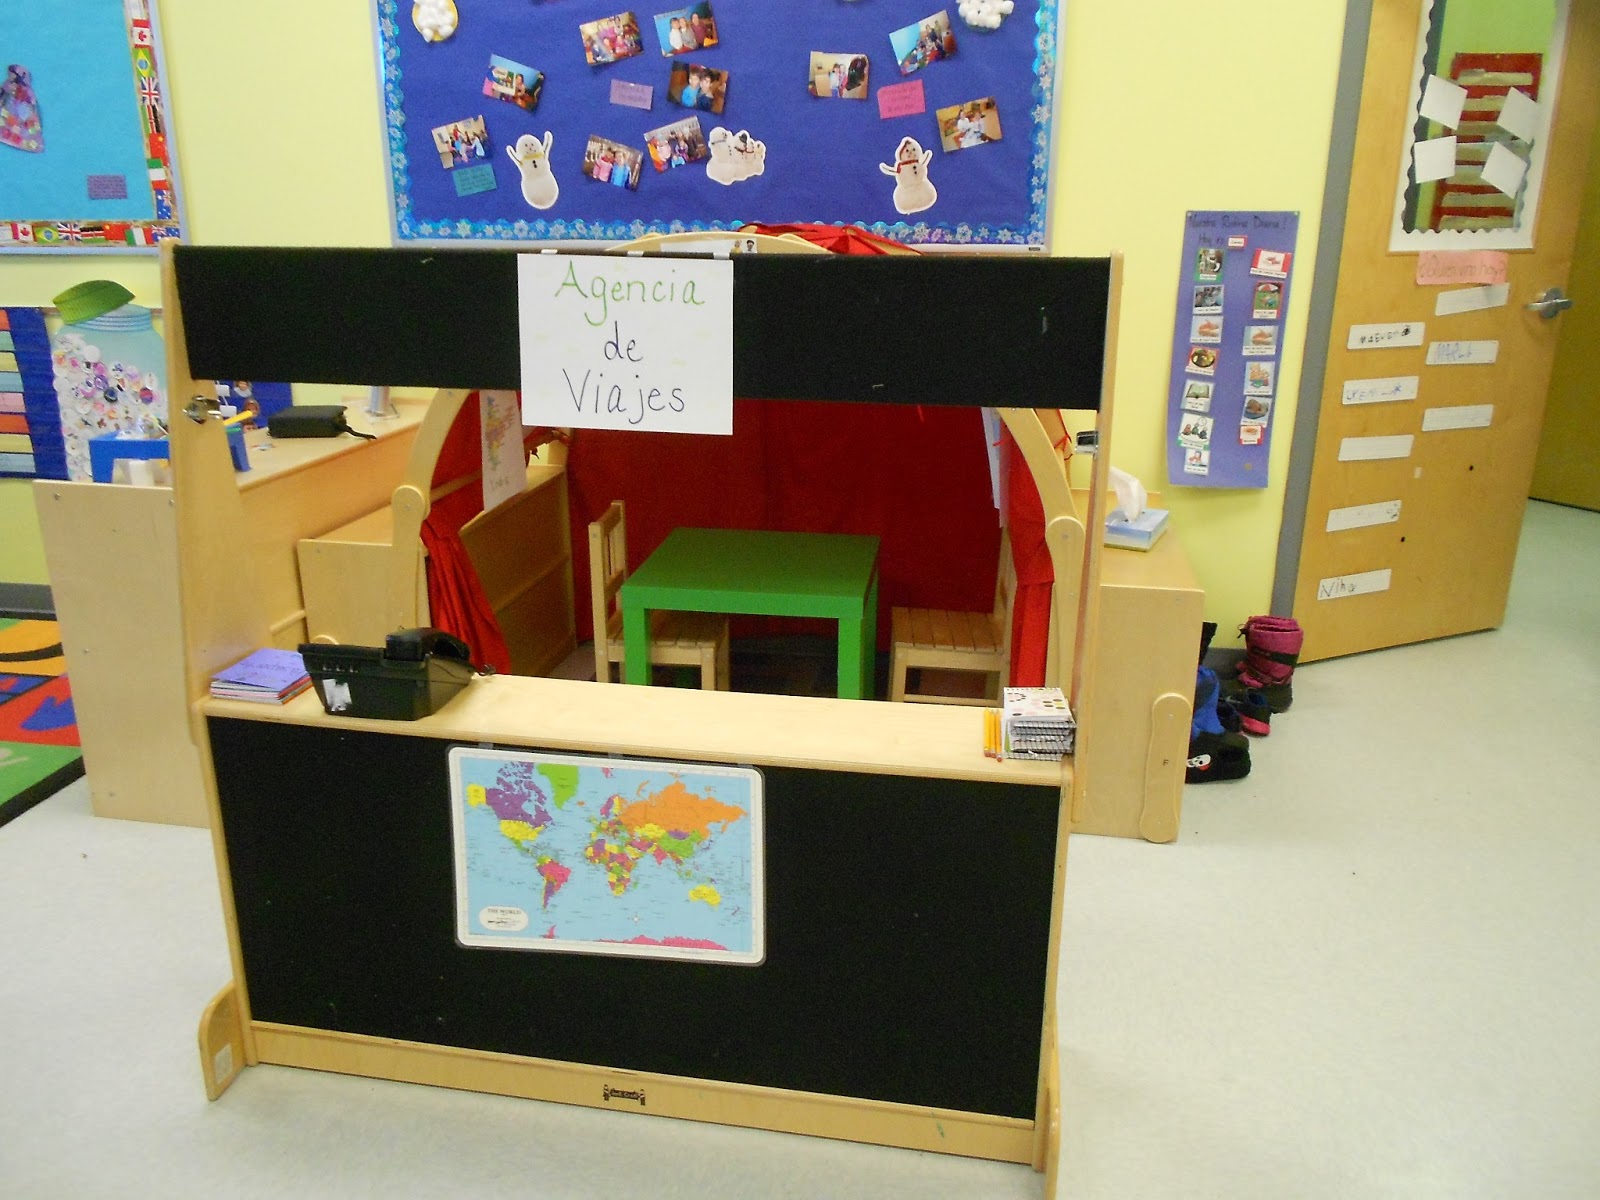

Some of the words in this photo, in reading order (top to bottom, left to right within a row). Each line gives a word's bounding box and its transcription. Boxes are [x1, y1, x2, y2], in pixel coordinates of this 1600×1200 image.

[555, 260, 705, 327] Agencia
[604, 320, 643, 362] de
[562, 368, 685, 425] Viajes
